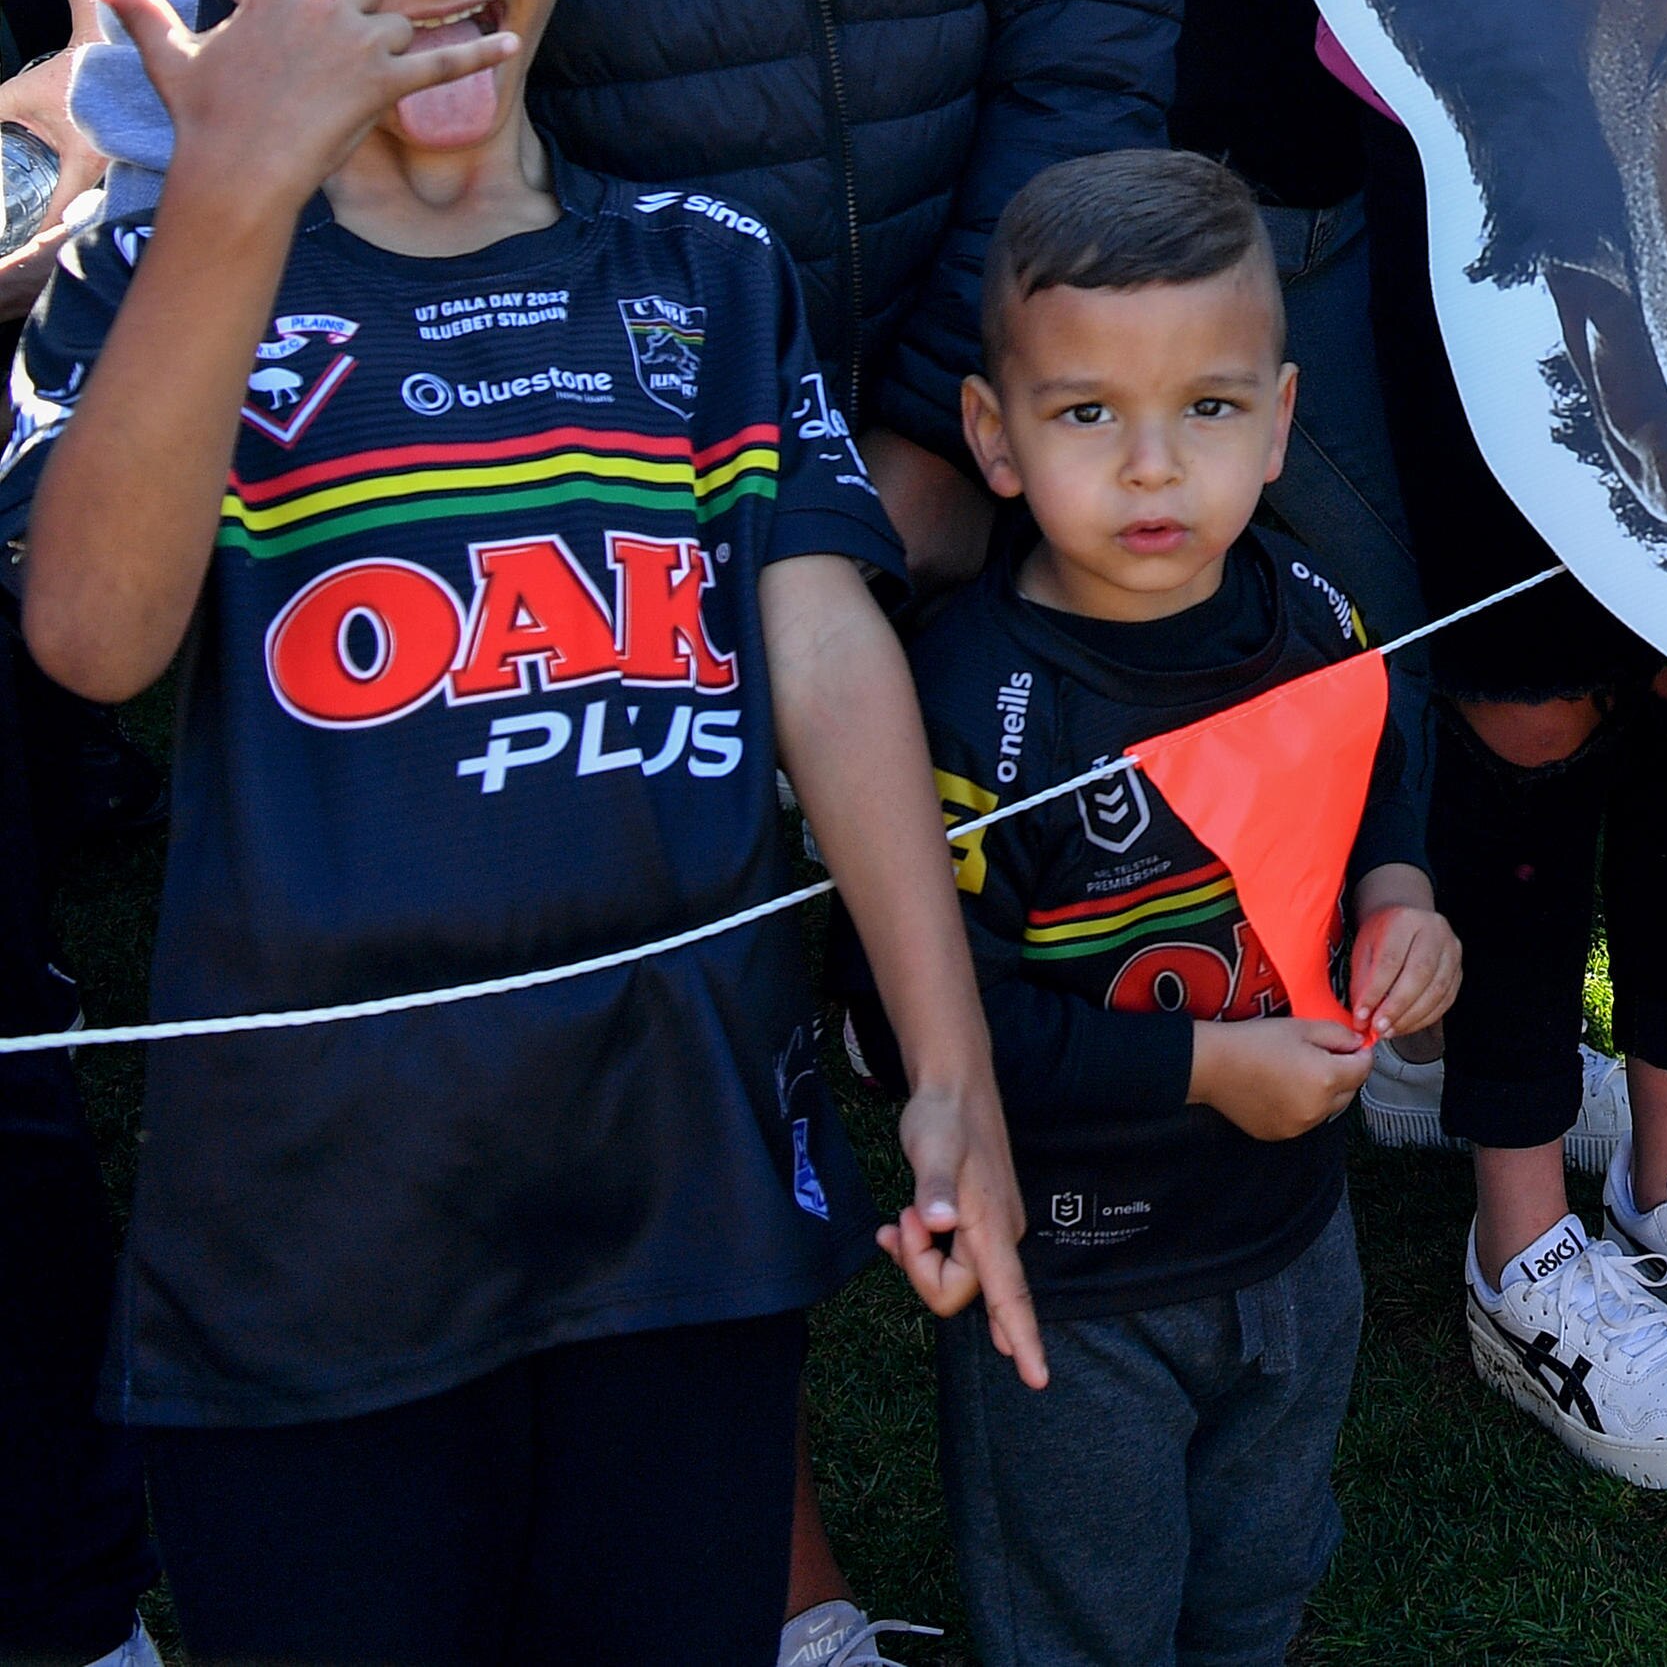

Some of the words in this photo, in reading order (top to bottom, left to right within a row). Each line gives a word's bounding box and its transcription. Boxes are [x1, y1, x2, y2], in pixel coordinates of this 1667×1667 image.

[291, 317, 345, 332] PLAINS
[414, 304, 438, 322] U7
[440, 296, 488, 317] GALA
[489, 293, 525, 308] DAY
[418, 313, 494, 341] BLUEBET
[457, 366, 613, 408] bluestone
[264, 530, 739, 731] OAK
[457, 700, 744, 796] PLUS
[996, 670, 1034, 784] oneills
[1086, 859, 1173, 893] PREMIERSHIP
[1104, 920, 1292, 1024] OA
